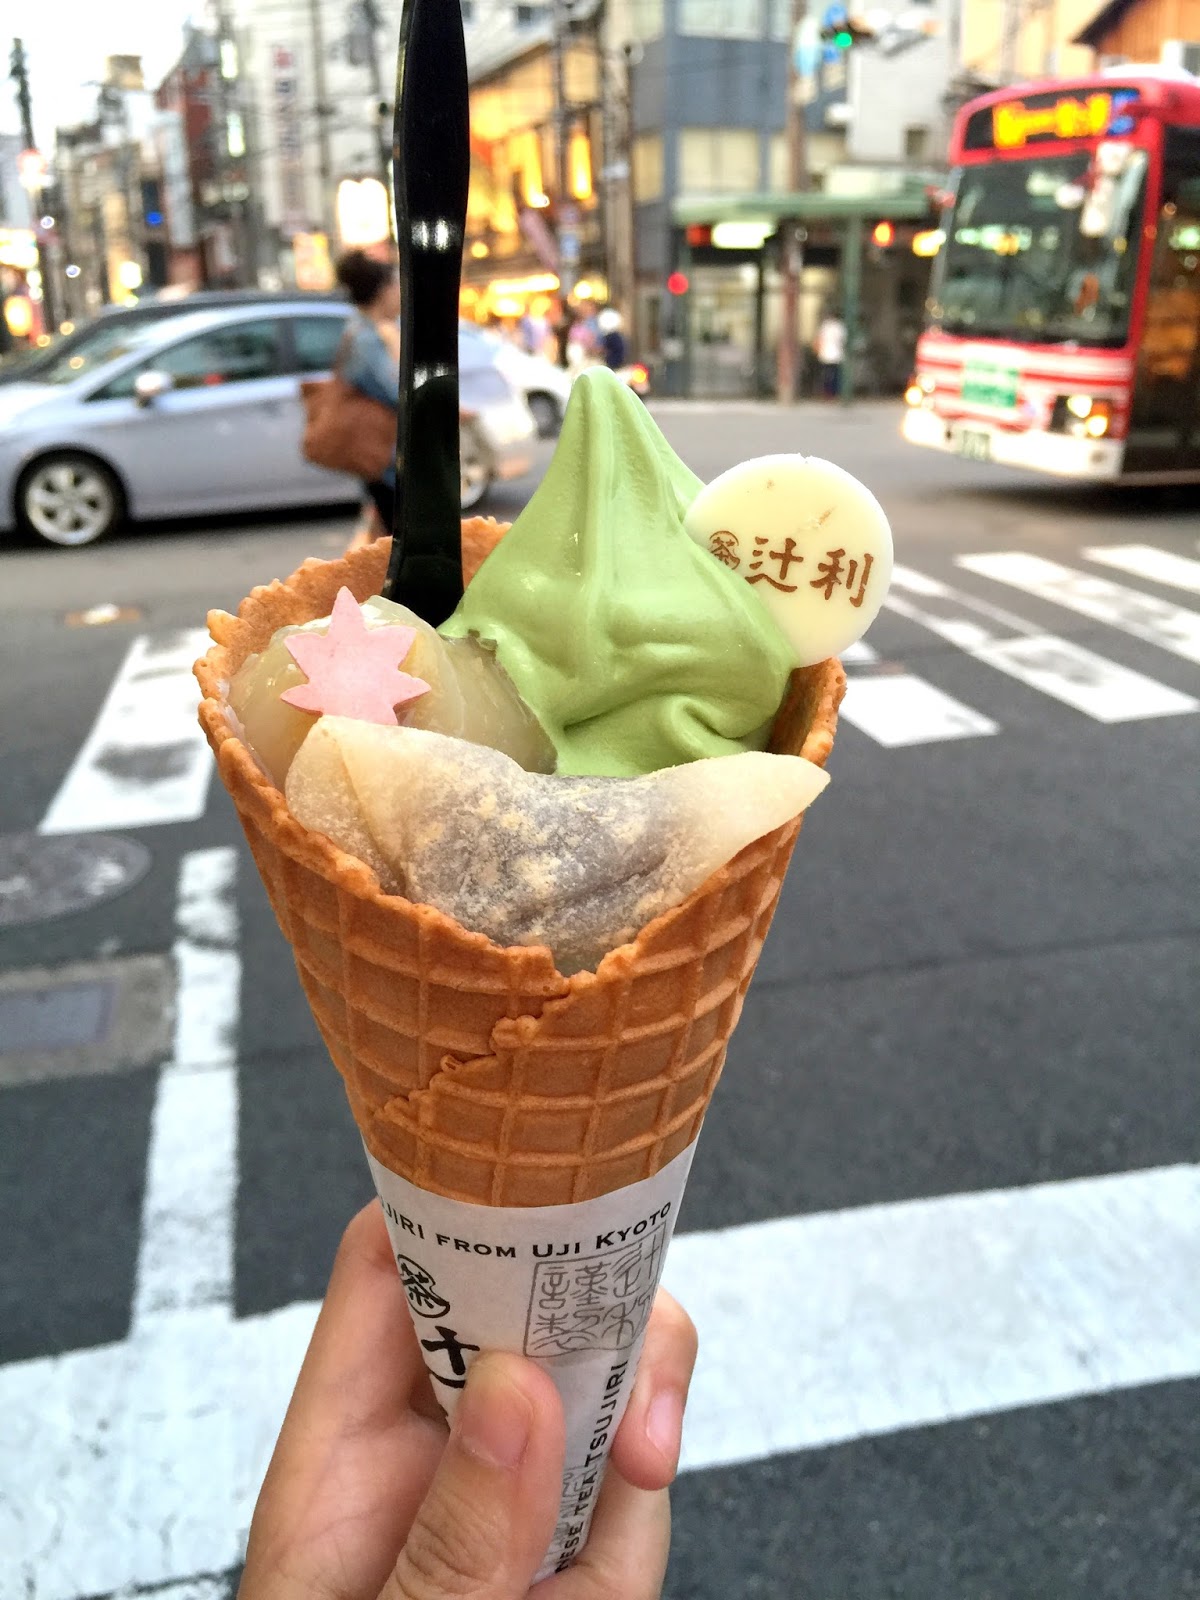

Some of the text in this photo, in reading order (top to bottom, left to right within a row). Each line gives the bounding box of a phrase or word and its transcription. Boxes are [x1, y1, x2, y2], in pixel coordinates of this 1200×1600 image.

[745, 537, 874, 608] 辻利
[380, 1197, 672, 1258] JIRI FROM UJI KYOTO
[583, 1359, 629, 1469] TSUJIRI
[573, 1470, 599, 1517] TEA
